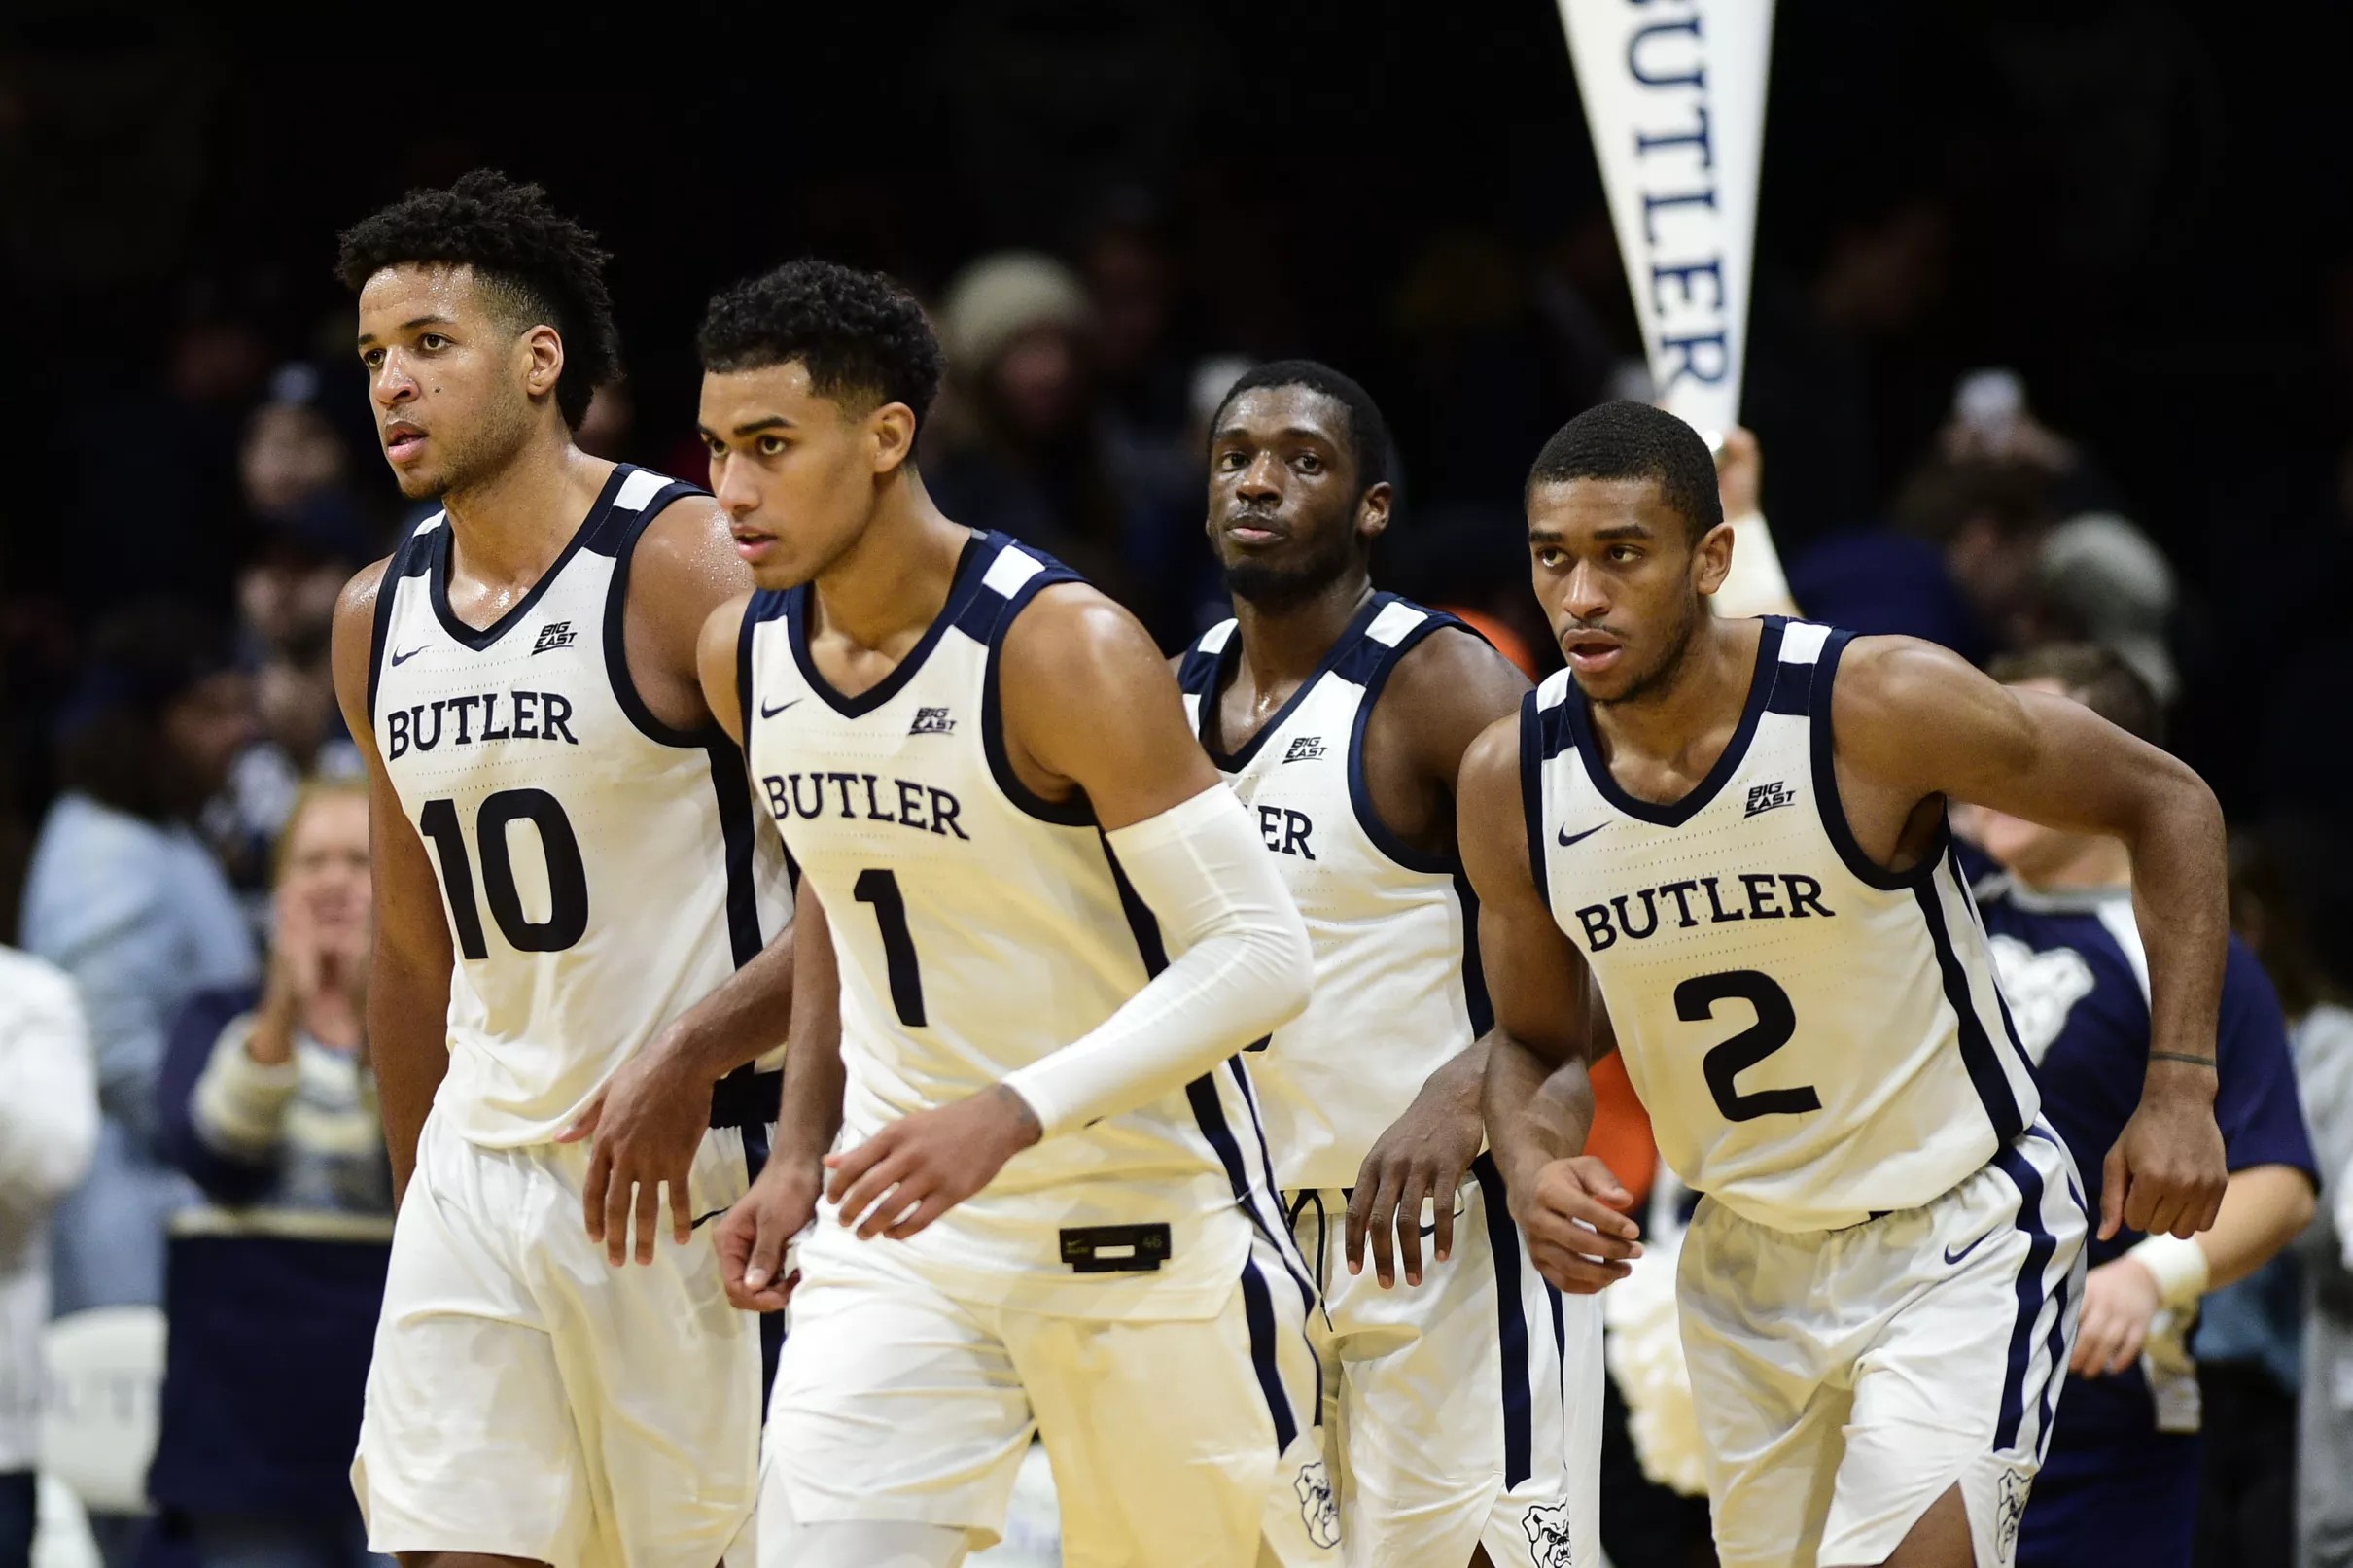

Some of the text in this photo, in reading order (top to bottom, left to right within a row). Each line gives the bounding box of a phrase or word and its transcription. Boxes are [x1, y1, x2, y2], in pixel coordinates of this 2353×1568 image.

[1625, 0, 1728, 392] UTLER
[534, 632, 578, 648] EAST
[540, 621, 572, 637] BIG
[917, 707, 950, 717] BIG
[388, 691, 579, 761] BUTLER
[911, 718, 957, 729] EAST
[1285, 747, 1327, 758] EAST
[1291, 737, 1321, 749] BIG
[1745, 790, 1796, 812] EAST
[1748, 781, 1784, 799] BIG
[763, 773, 970, 841] BUTLER
[420, 788, 589, 959] 10
[1575, 874, 1836, 952] BUTLER
[853, 869, 928, 1028] 1
[1673, 969, 1823, 1122] 2
